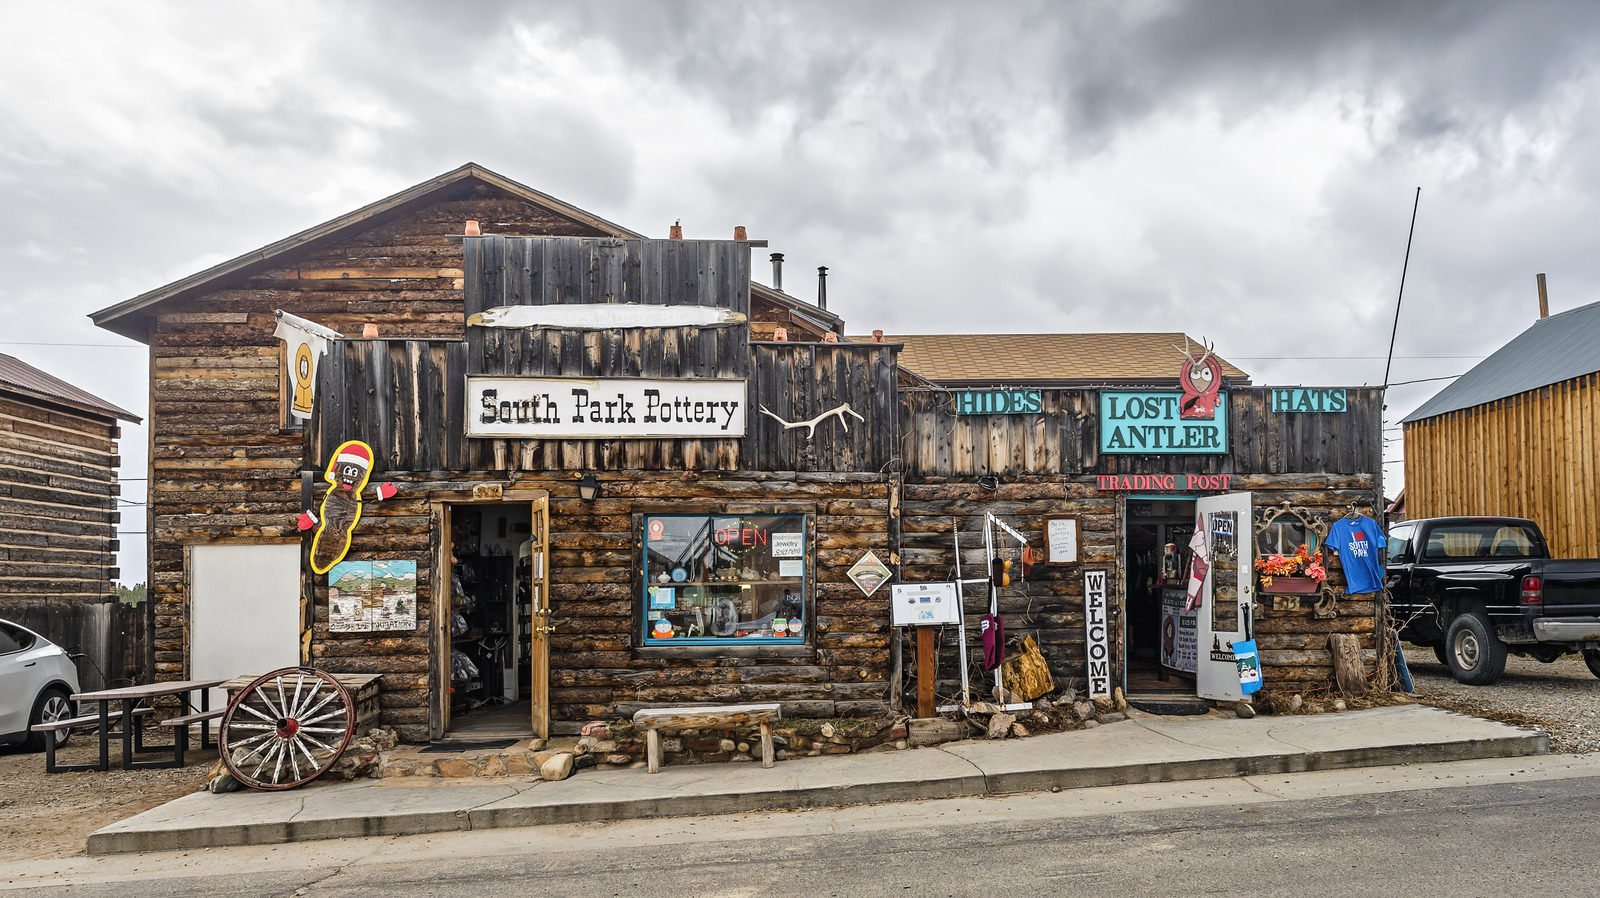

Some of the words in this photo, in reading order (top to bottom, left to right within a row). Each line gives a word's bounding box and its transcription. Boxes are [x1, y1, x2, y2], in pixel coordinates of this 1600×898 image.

[480, 389, 560, 424] South
[572, 389, 635, 423] Park
[644, 389, 738, 430] Pottery
[958, 390, 1041, 414] HIDES
[1108, 397, 1178, 420] LOST
[1274, 389, 1345, 412] HATS
[1106, 425, 1220, 448] ANTLER
[1097, 475, 1175, 490] TRADING
[1186, 475, 1231, 490] POST
[714, 528, 767, 547] OPEN
[1212, 518, 1233, 534] OPEN
[1351, 532, 1356, 542] I
[1087, 574, 1107, 694] WELCOME
[1211, 653, 1236, 661] WELCOME
